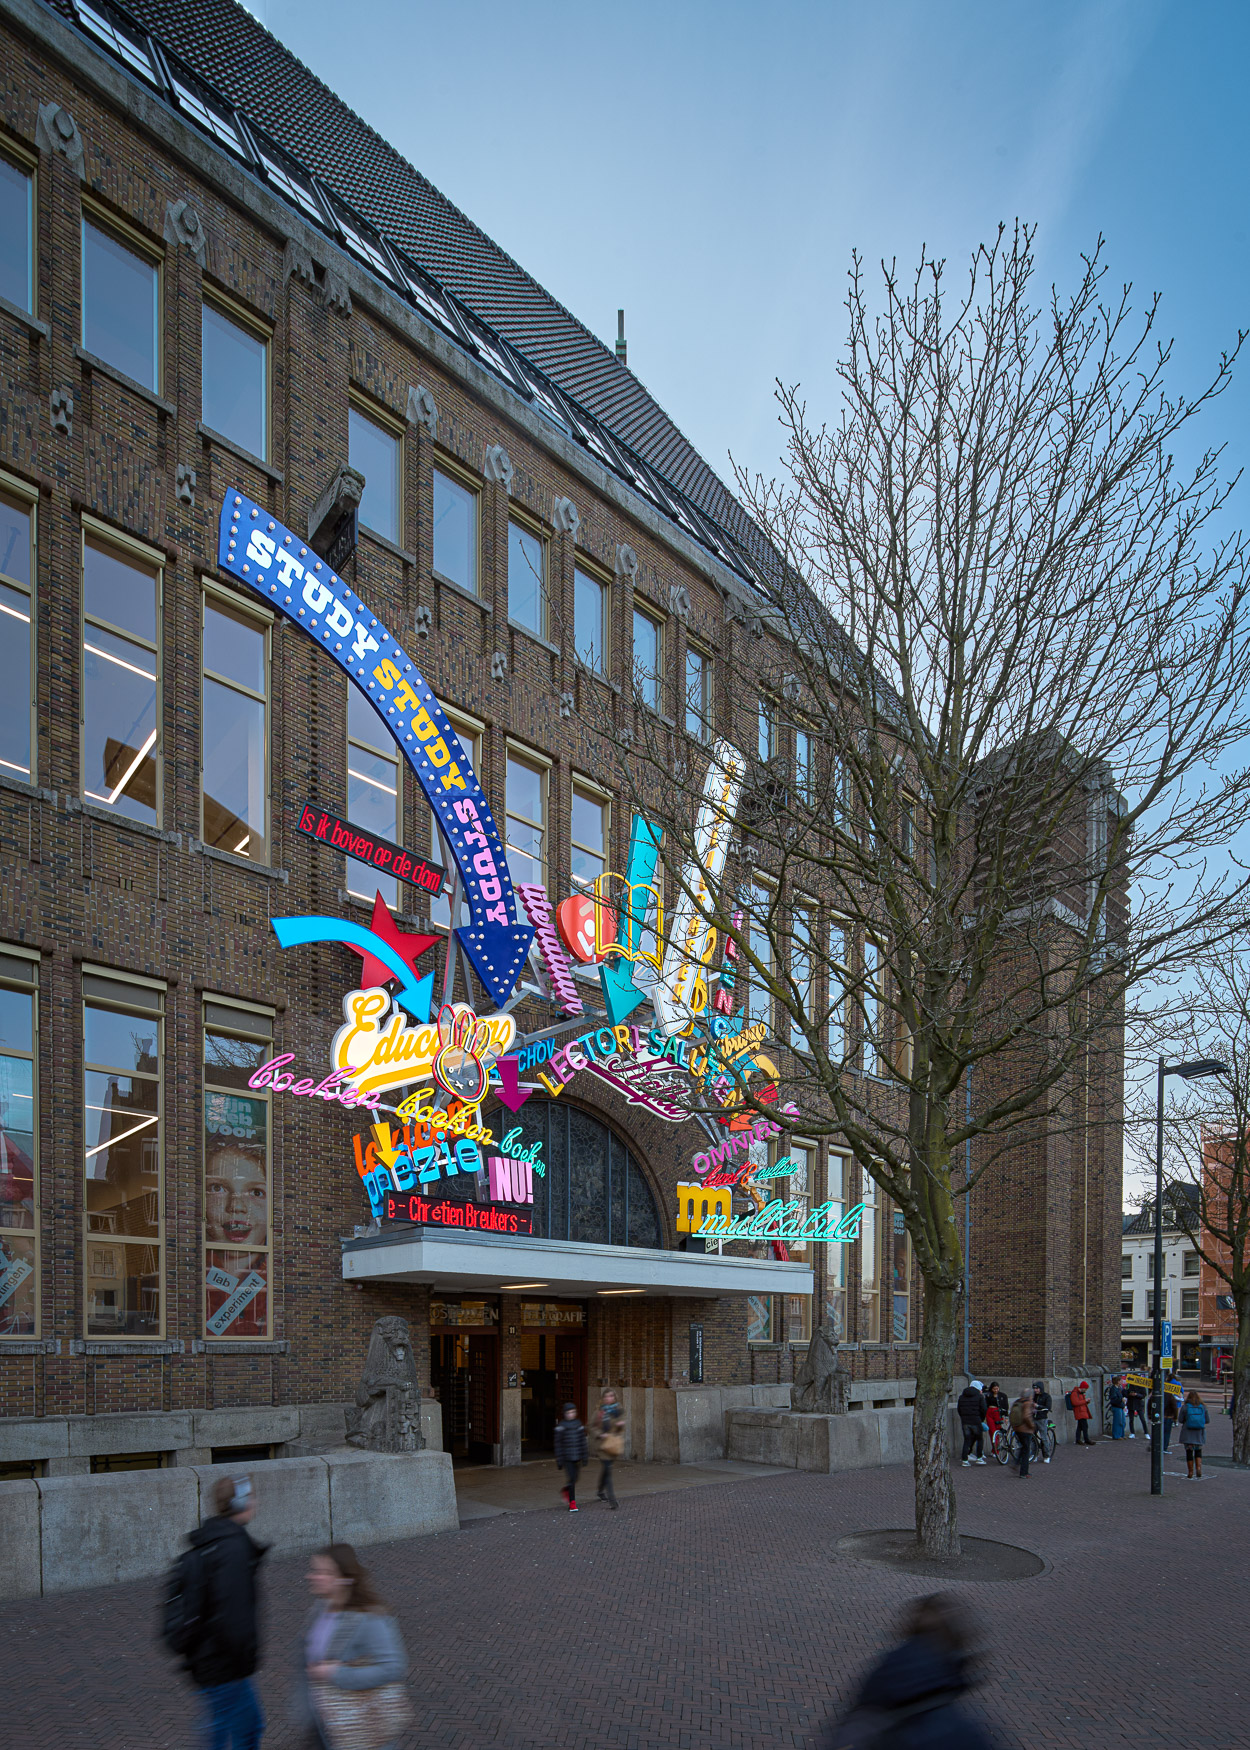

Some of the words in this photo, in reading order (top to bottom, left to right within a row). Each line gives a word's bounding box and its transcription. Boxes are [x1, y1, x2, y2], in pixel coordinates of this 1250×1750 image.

[246, 530, 380, 660] STUDY
[372, 658, 467, 793] STUDY
[452, 798, 509, 926] STUDY
[316, 813, 327, 840] ik
[330, 819, 374, 861] boven
[374, 847, 392, 866] op
[392, 855, 410, 878] de
[413, 862, 441, 892] dom
[516, 882, 584, 1016] literatuur
[248, 1053, 381, 1110] boeken
[537, 1025, 643, 1097] LECTORI
[206, 1122, 257, 1139] voor
[396, 1087, 493, 1146] boeken
[500, 1126, 546, 1179] boeken
[741, 1163, 758, 1185] &
[489, 1157, 534, 1204] NU!
[465, 1203, 518, 1232] Breukers
[696, 1198, 866, 1240] multatuli
[212, 1272, 231, 1289] lab
[213, 1277, 261, 1330] experiment
